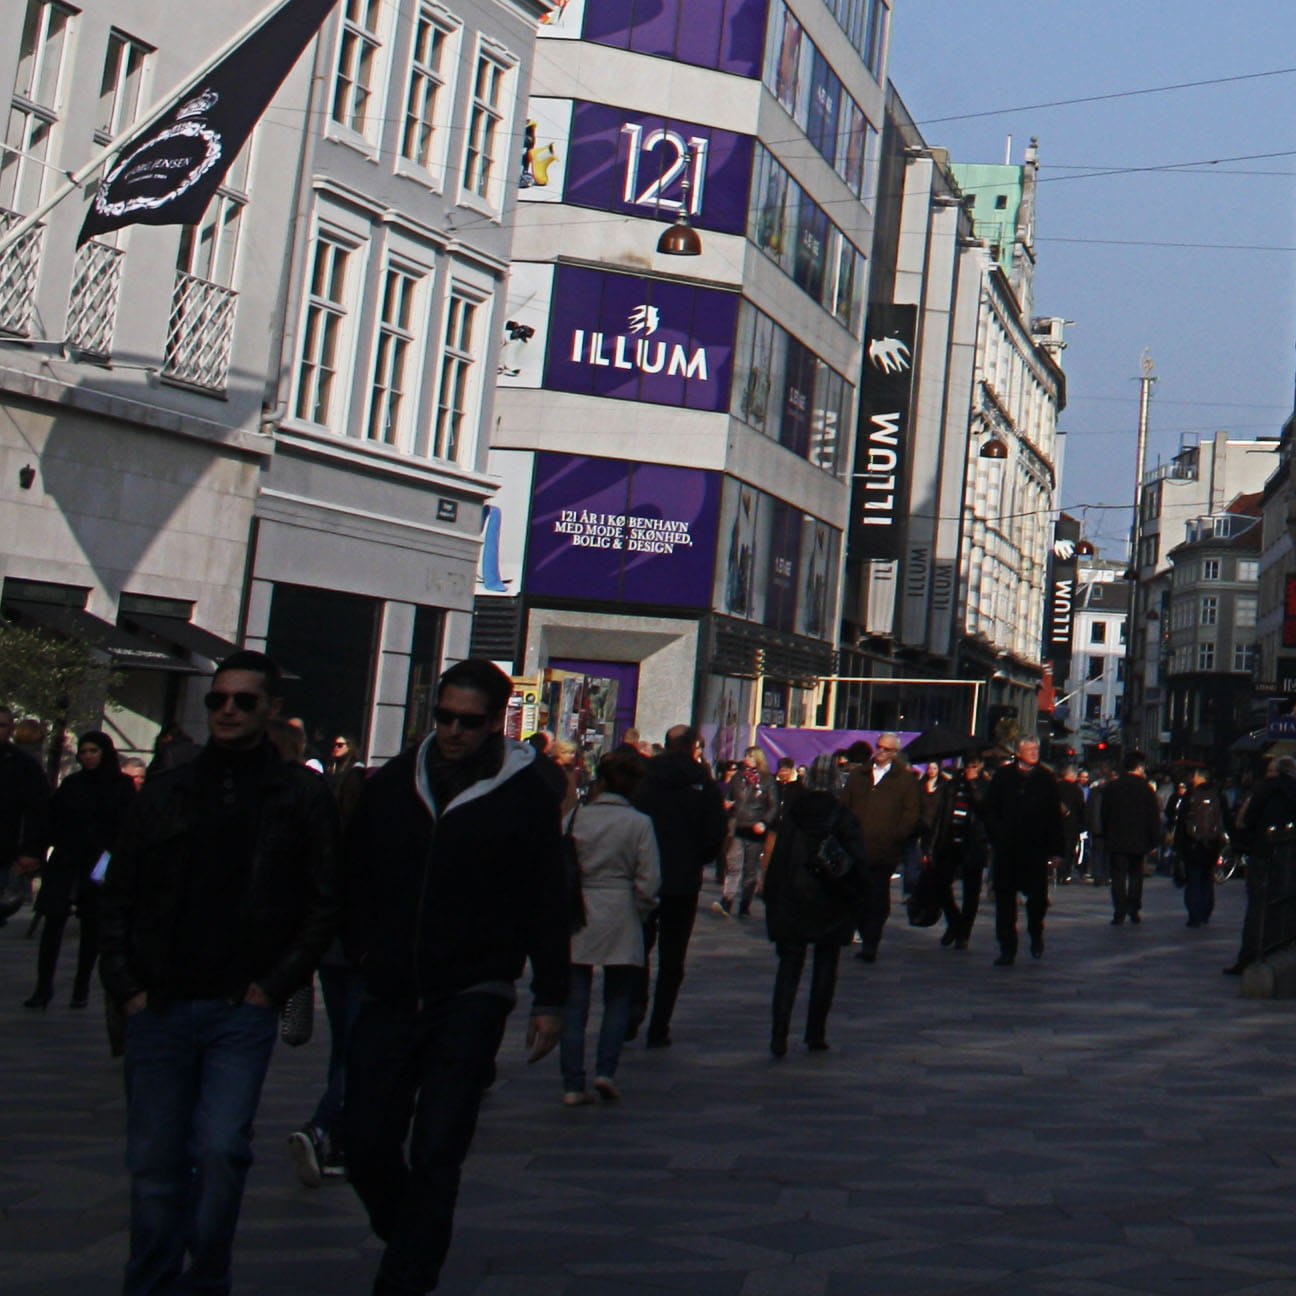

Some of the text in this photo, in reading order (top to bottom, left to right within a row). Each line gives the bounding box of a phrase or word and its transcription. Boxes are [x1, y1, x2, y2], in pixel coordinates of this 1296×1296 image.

[621, 122, 709, 215] 121
[572, 329, 708, 380] ILLUM
[863, 412, 901, 525] ILLUM
[554, 521, 583, 535] MED
[561, 510, 577, 523] 121
[579, 509, 597, 524] ÅR
[572, 535, 674, 554] BOLIG & DESIGN
[908, 548, 928, 597] ILLUM
[934, 565, 952, 610] ILLUM
[1051, 580, 1072, 642] ILLUM
